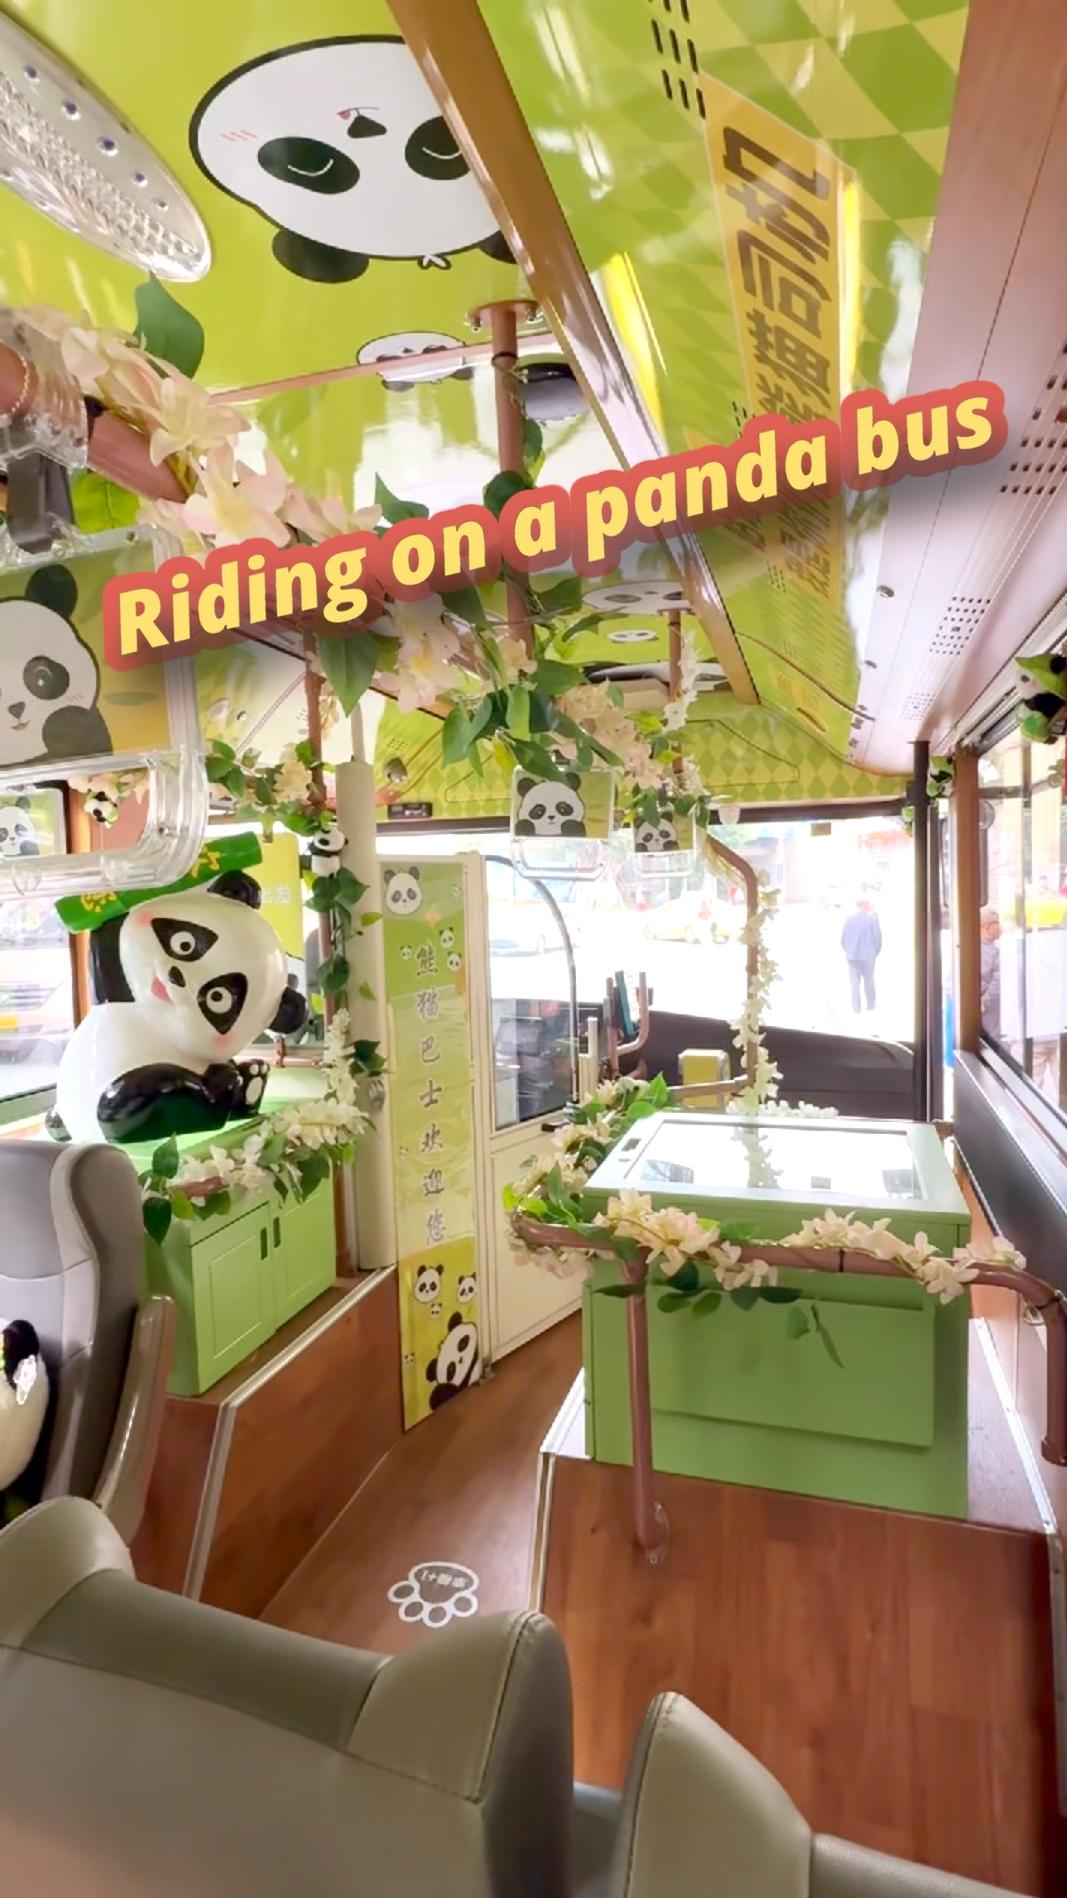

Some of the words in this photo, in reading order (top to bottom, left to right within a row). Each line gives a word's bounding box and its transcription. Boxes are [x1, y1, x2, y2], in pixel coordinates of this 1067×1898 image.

[416, 945, 447, 1245] 熊猫巴士欢迎您
